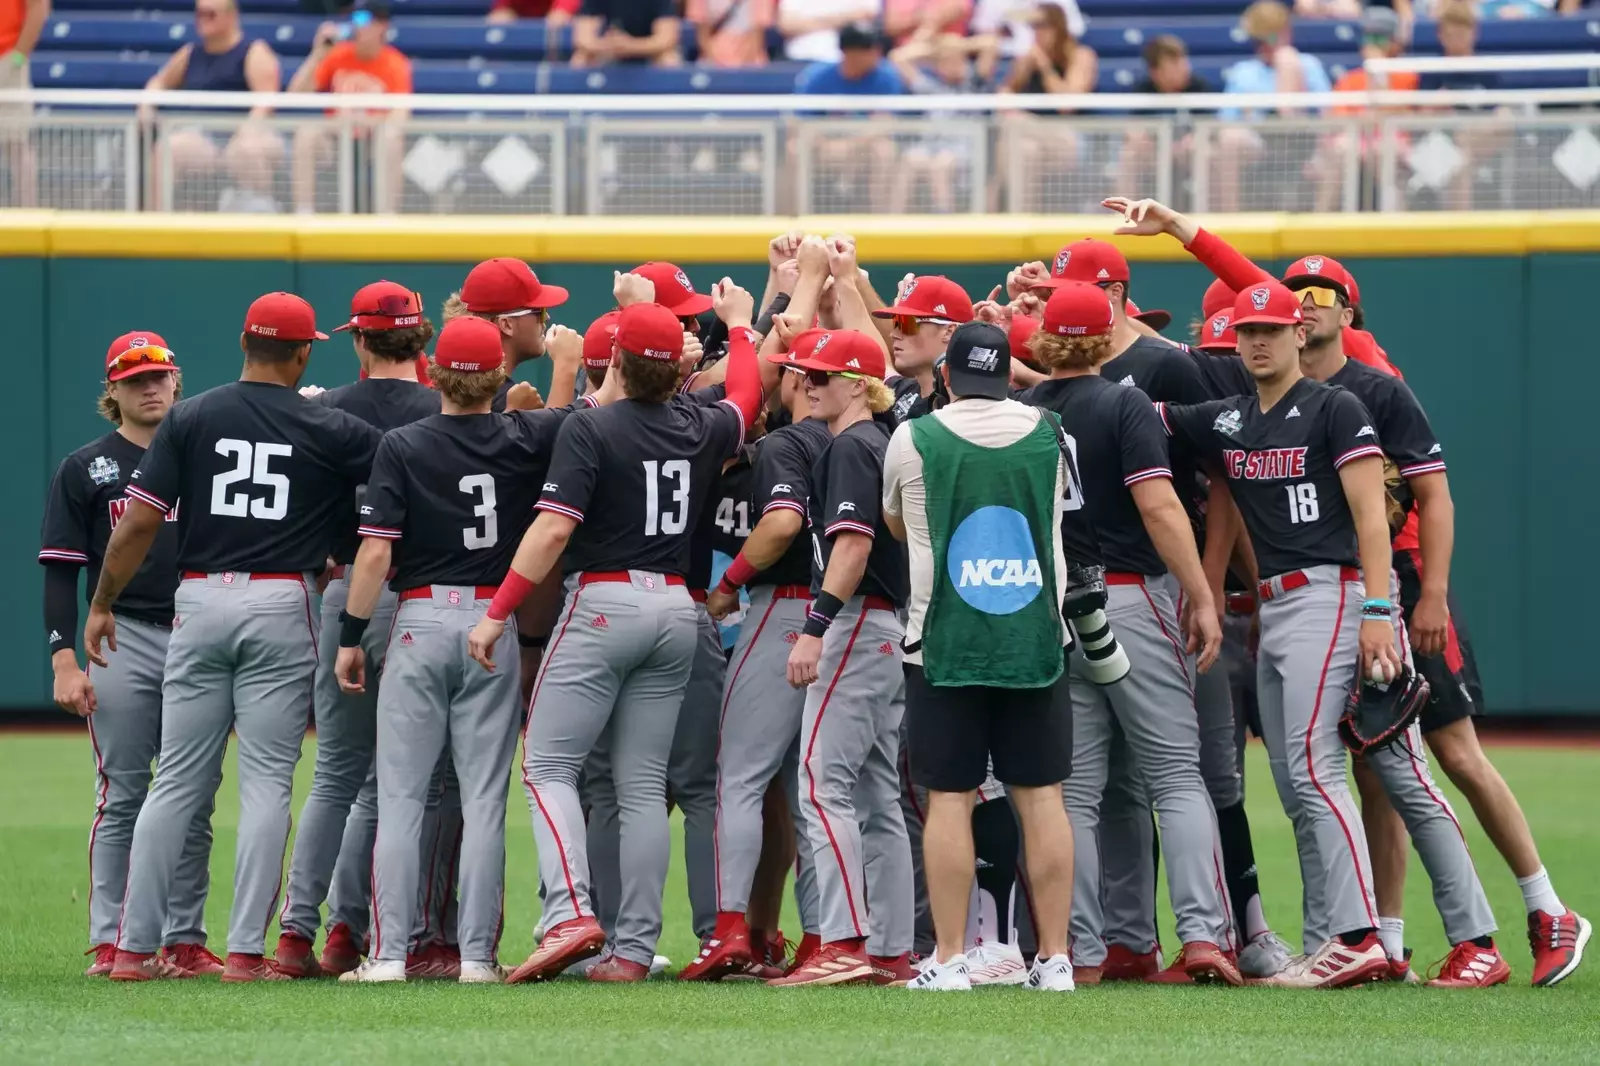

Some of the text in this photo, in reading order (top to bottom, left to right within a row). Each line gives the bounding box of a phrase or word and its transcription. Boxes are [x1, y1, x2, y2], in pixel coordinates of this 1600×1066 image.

[250, 323, 279, 337] NC STATE
[394, 315, 420, 326] NC STATE
[1058, 324, 1088, 335] NC STATE
[450, 360, 481, 371] NC STATE
[644, 348, 673, 360] NC STATE
[210, 437, 293, 521] 25
[1244, 446, 1309, 480] STATE
[458, 472, 499, 551] 3
[642, 459, 691, 537] 13
[1284, 482, 1320, 524] 18
[714, 497, 752, 538] 41
[959, 558, 1044, 588] NCAA
